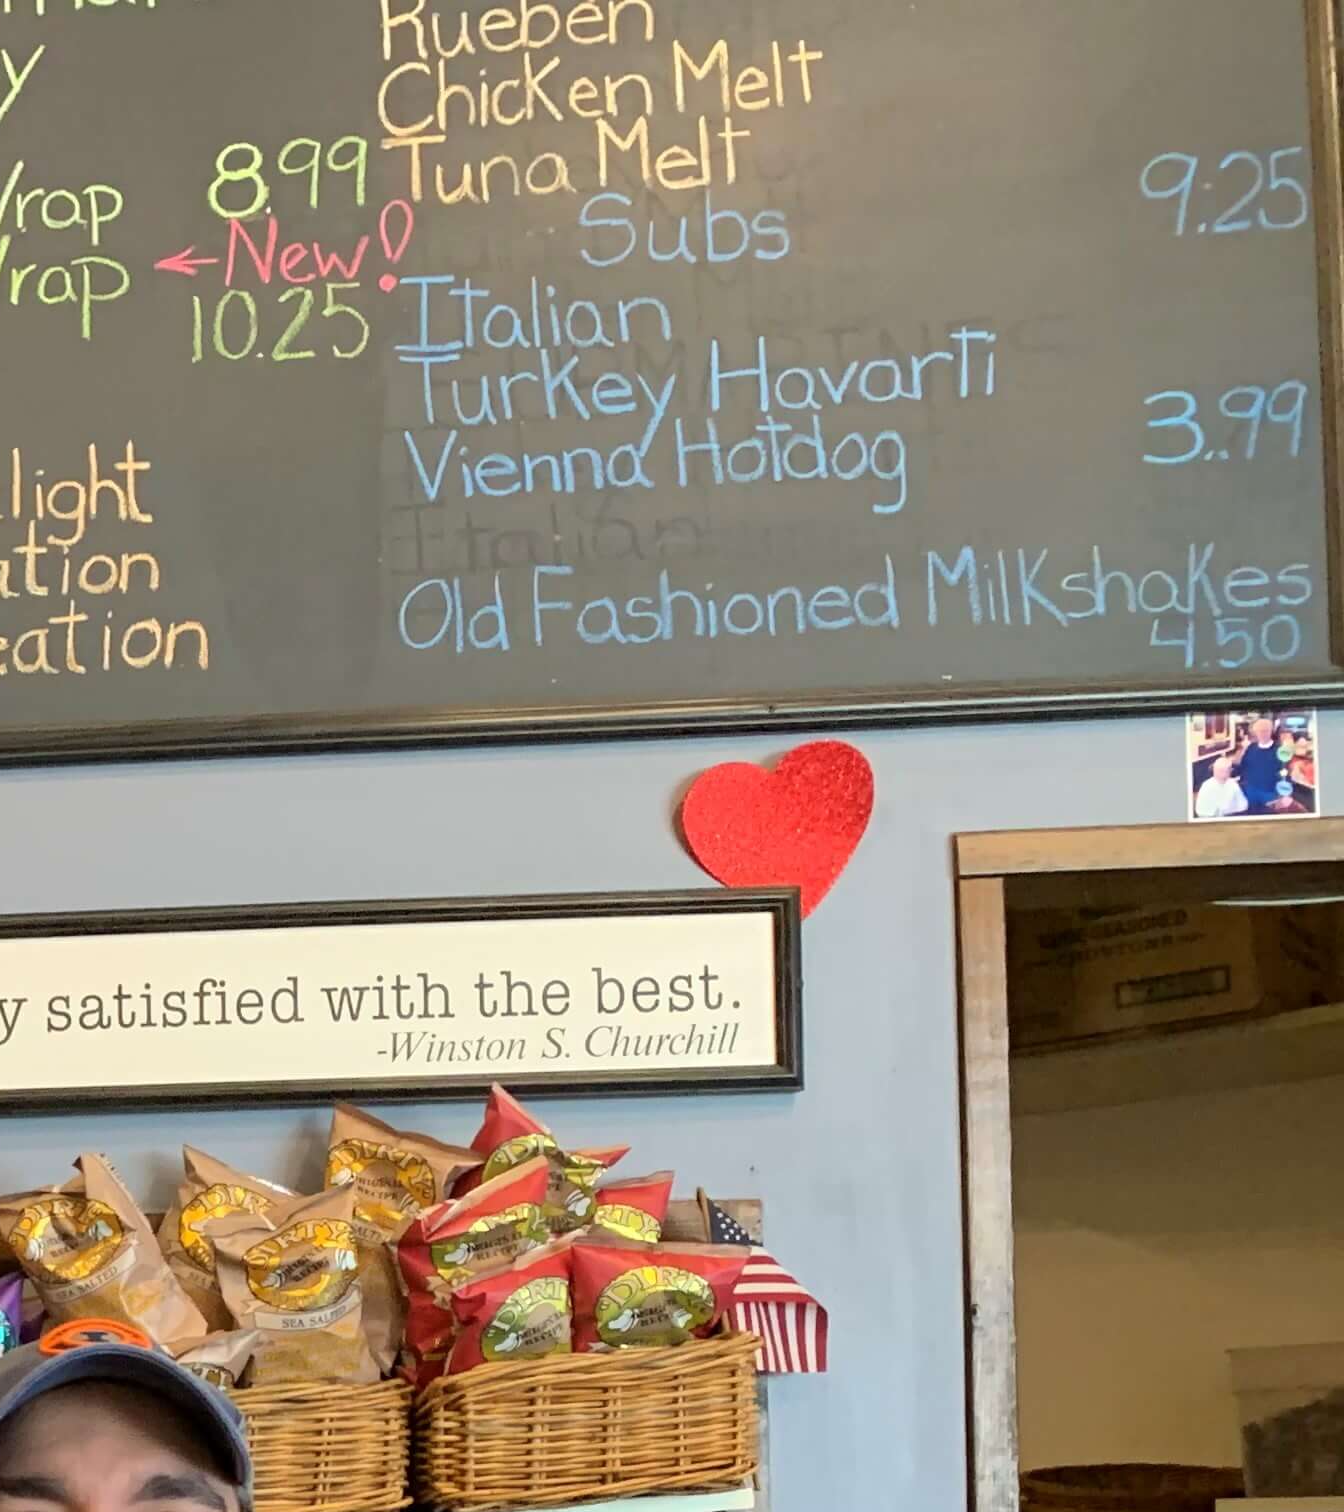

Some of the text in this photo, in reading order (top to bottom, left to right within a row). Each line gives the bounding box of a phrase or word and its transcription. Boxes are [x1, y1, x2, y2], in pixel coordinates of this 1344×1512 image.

[377, 40, 823, 136] Chicken Melt
[381, 116, 751, 204] Tuna Melt
[225, 202, 414, 292] New!
[579, 193, 790, 266] Subs
[191, 282, 370, 361] 10.25
[395, 275, 672, 351] Italian
[399, 326, 996, 459] Turkey Havarti
[404, 418, 907, 514] Vienna Hotdog
[400, 574, 509, 652] Old
[531, 554, 898, 645] Fashioned
[1148, 613, 1302, 668] 4.50
[46, 977, 305, 1034] satisfied
[320, 971, 455, 1025] with
[475, 970, 572, 1018] the
[594, 964, 742, 1015] best.
[376, 1023, 737, 1065] -Winston S. Churchill
[281, 1317, 306, 1330] SEA
